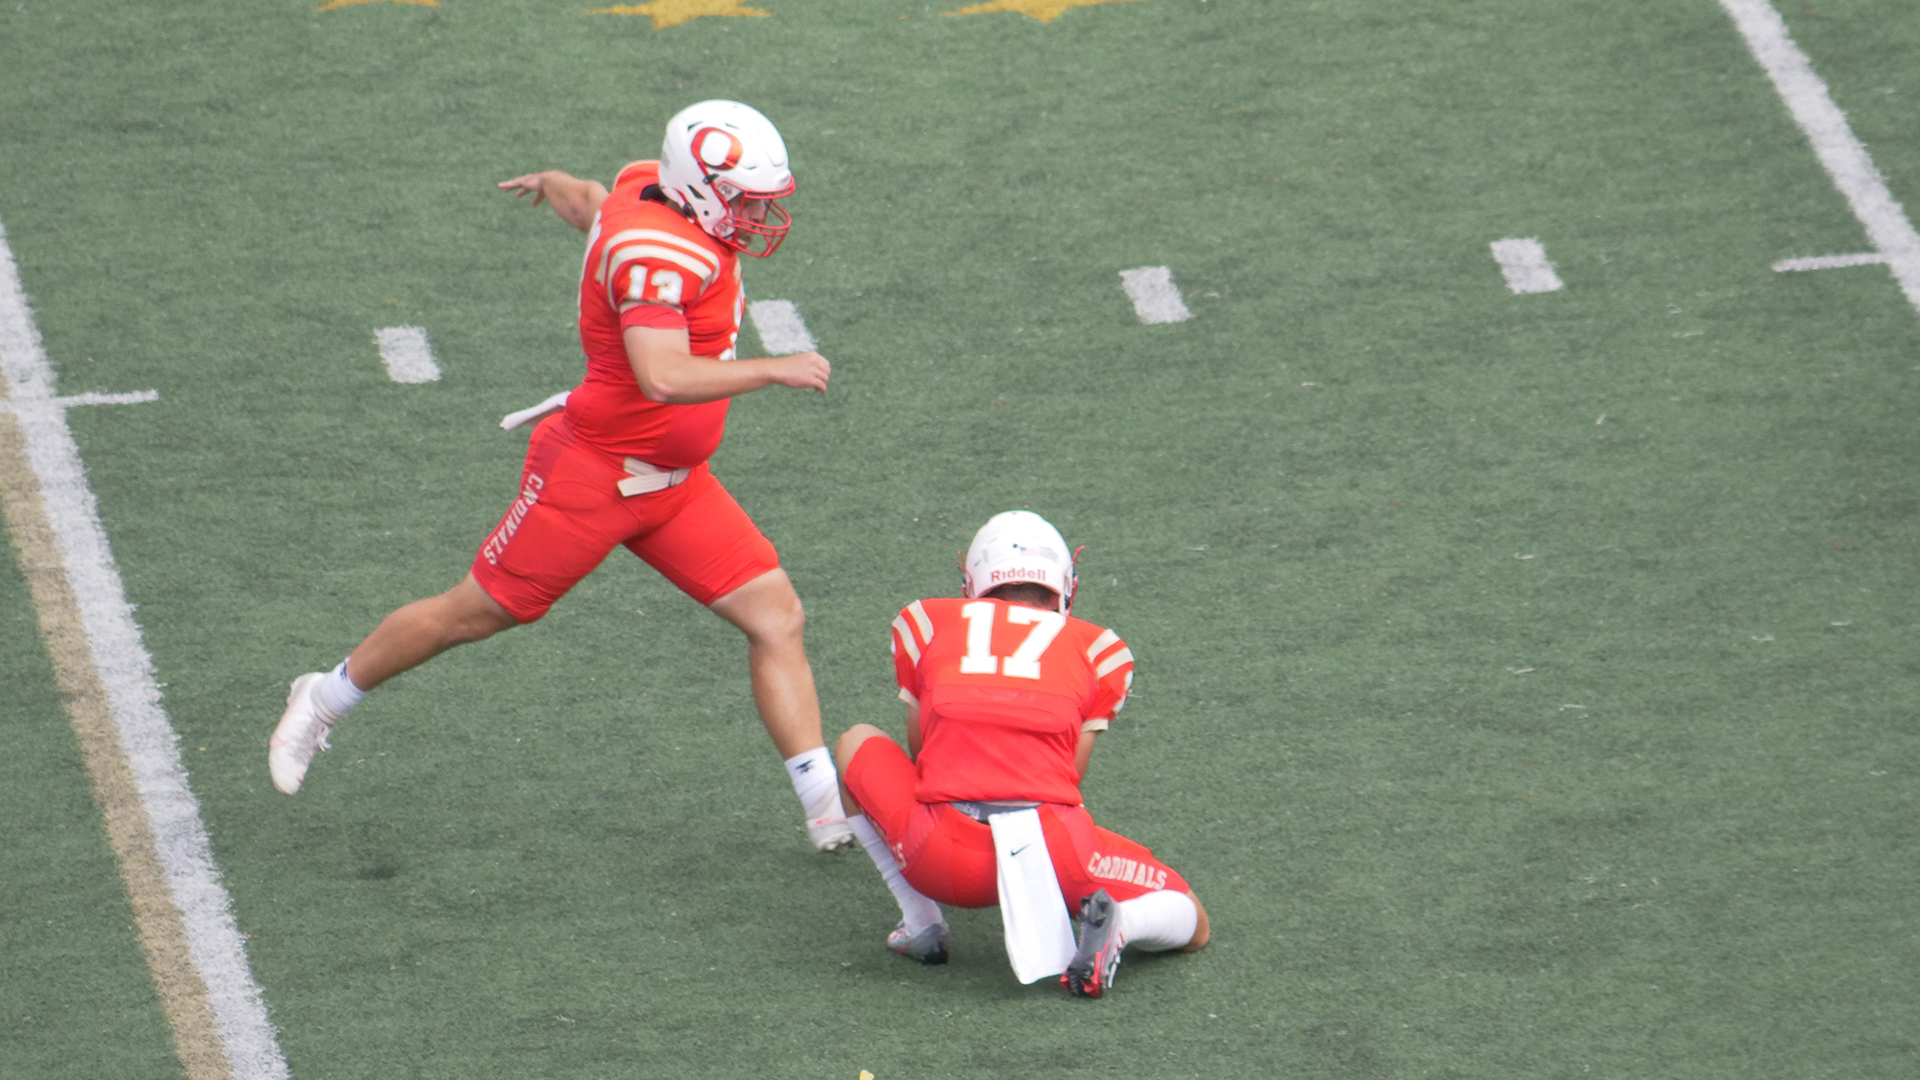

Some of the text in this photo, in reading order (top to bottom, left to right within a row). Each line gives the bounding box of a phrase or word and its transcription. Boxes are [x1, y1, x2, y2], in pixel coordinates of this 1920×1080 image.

[629, 264, 683, 304] 13
[991, 568, 1046, 582] Riddell
[960, 601, 1066, 679] 17
[1087, 852, 1167, 891] CARDINALS
